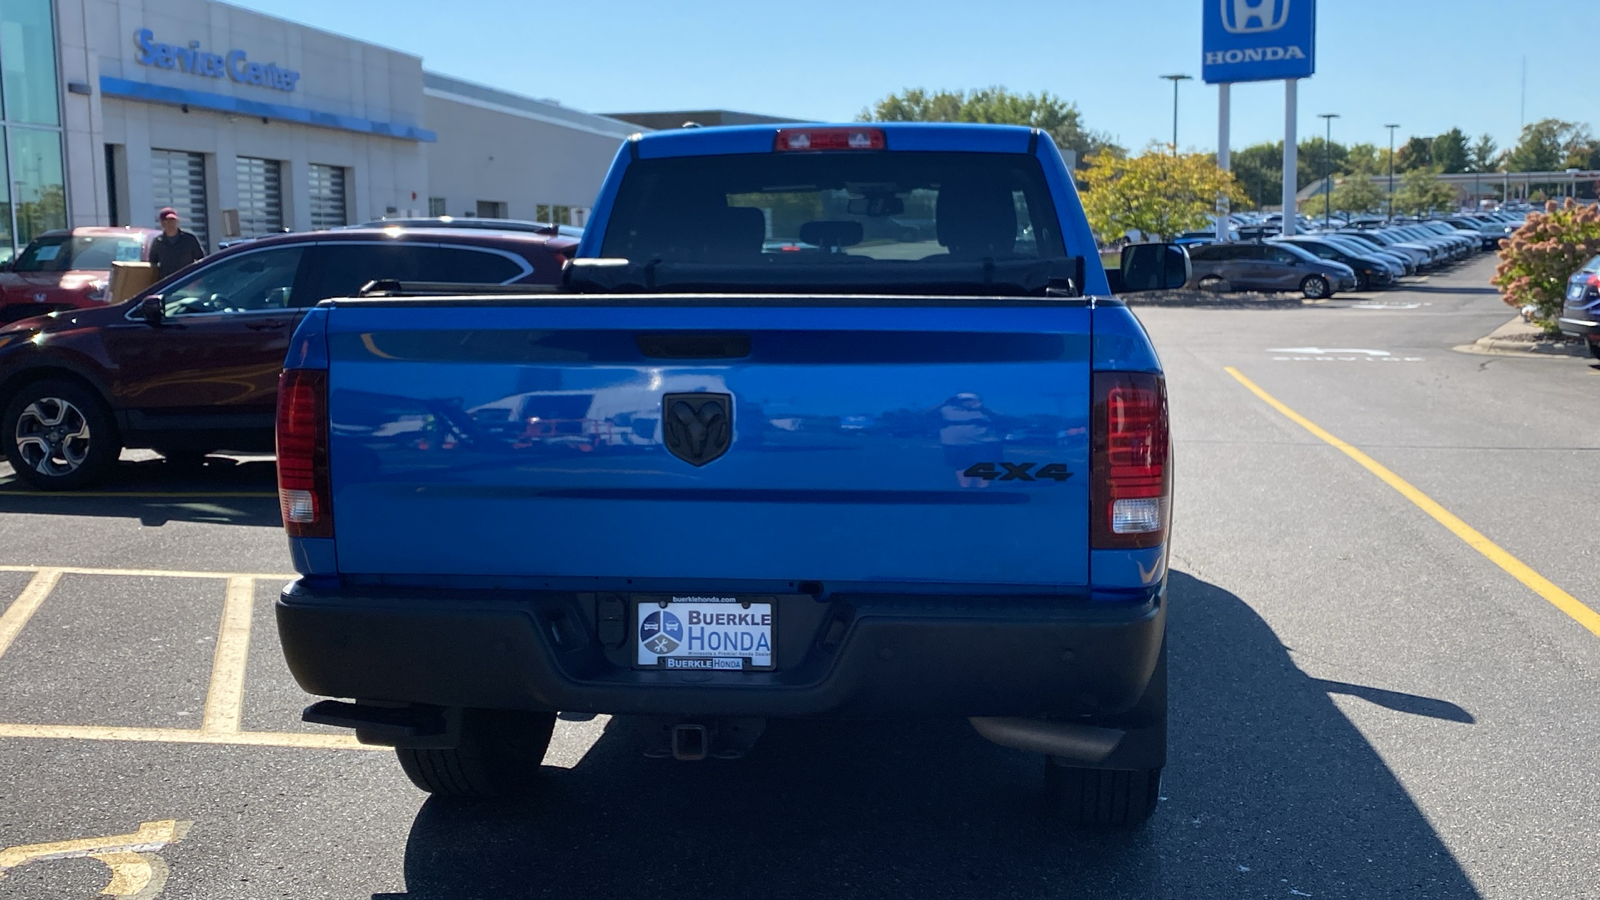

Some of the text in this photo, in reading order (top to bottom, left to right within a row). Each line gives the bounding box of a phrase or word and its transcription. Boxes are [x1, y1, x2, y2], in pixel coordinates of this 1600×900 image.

[133, 28, 299, 92] Service Center
[1205, 45, 1306, 65] HONDA
[963, 462, 1075, 482] 4X4
[688, 610, 771, 626] BUERKLE
[688, 626, 771, 651] HONDA
[667, 658, 741, 668] BUERKLE HONDA
